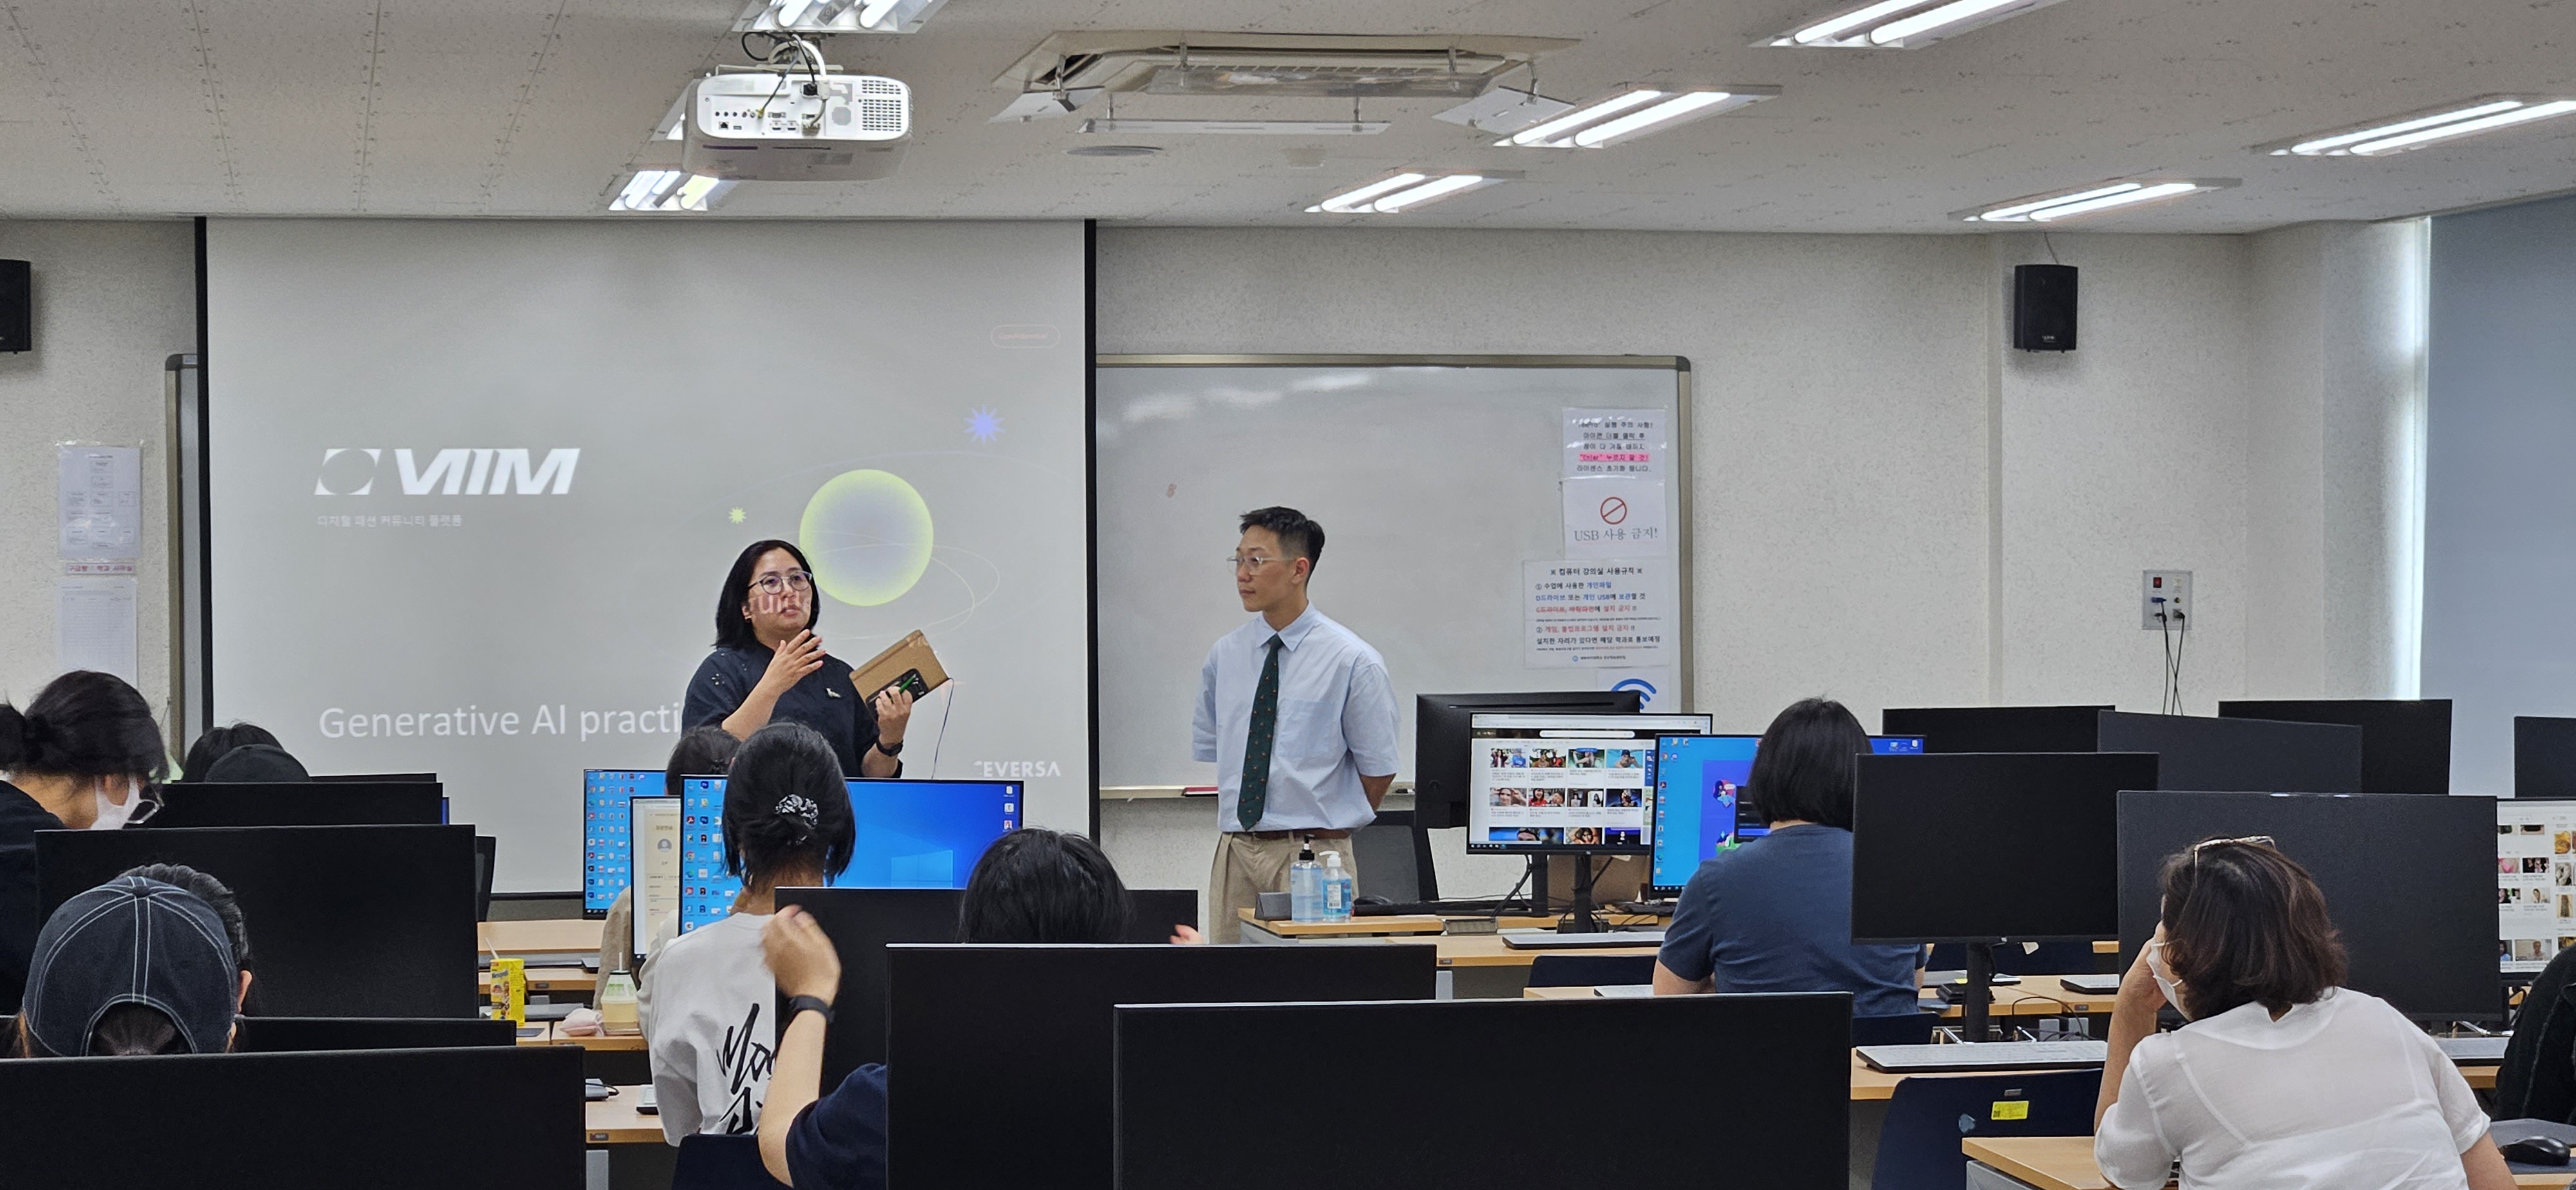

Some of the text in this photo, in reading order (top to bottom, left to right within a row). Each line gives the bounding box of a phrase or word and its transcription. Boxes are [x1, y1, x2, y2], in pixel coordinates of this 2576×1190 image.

[317, 515, 462, 527] 디지털 패션 커뮤니티 플랫폼
[1574, 526, 1658, 542] USB 사용 금지!
[1559, 568, 1580, 576] 컴퓨터
[1583, 567, 1604, 576] 강의실
[1607, 567, 1634, 575] 사용규칙
[1565, 581, 1584, 590] 사용한
[1562, 625, 1599, 633] 불법프로그램
[319, 702, 679, 742] Generative AI practi
